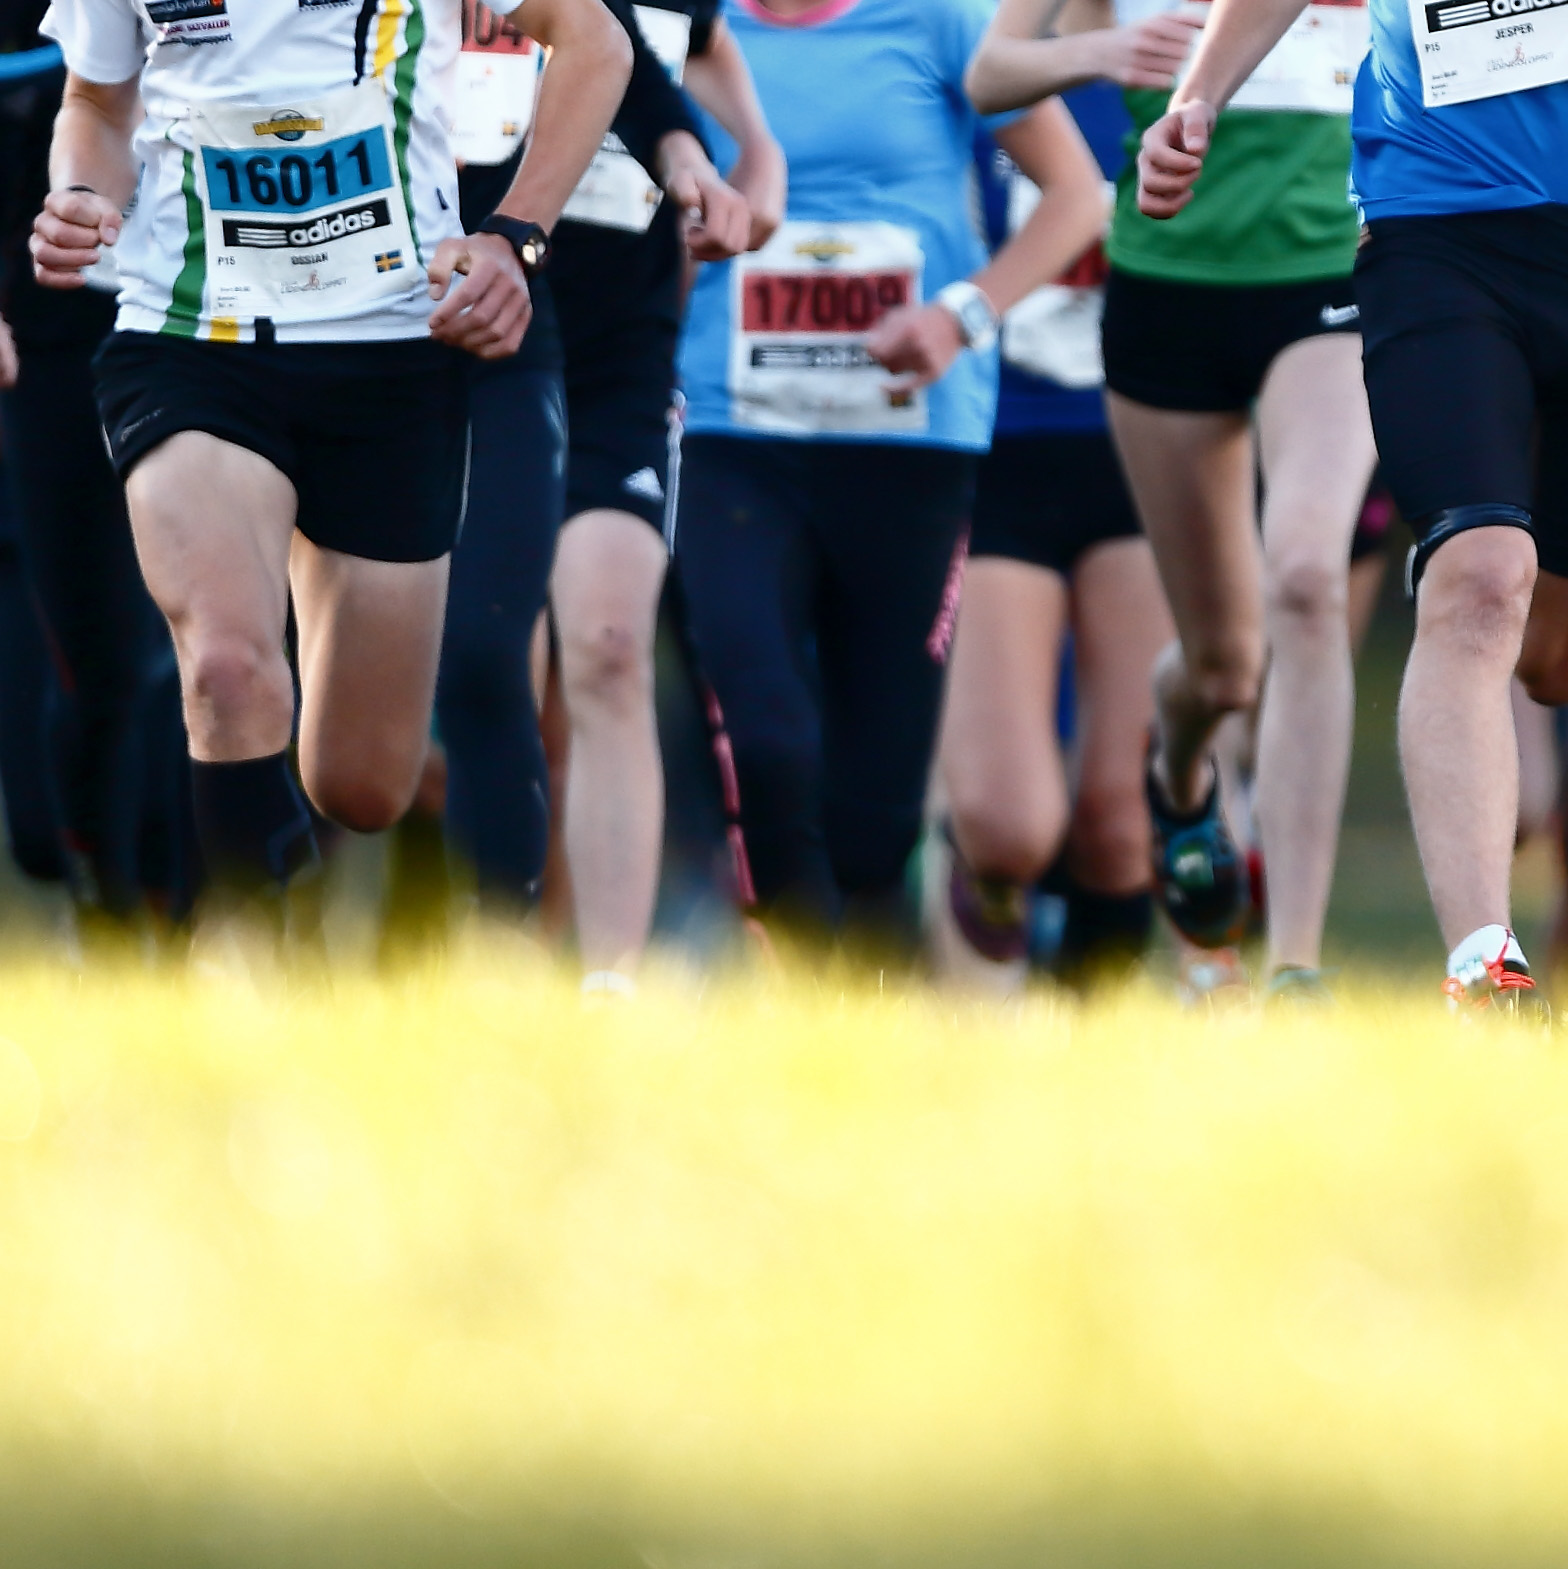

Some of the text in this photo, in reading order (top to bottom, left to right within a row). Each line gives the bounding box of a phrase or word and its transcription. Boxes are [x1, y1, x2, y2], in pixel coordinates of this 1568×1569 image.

[1495, 22, 1535, 40] JESPER
[1425, 42, 1441, 53] P15
[215, 138, 373, 206] 16011
[289, 210, 376, 246] adidas
[216, 255, 236, 266] P15
